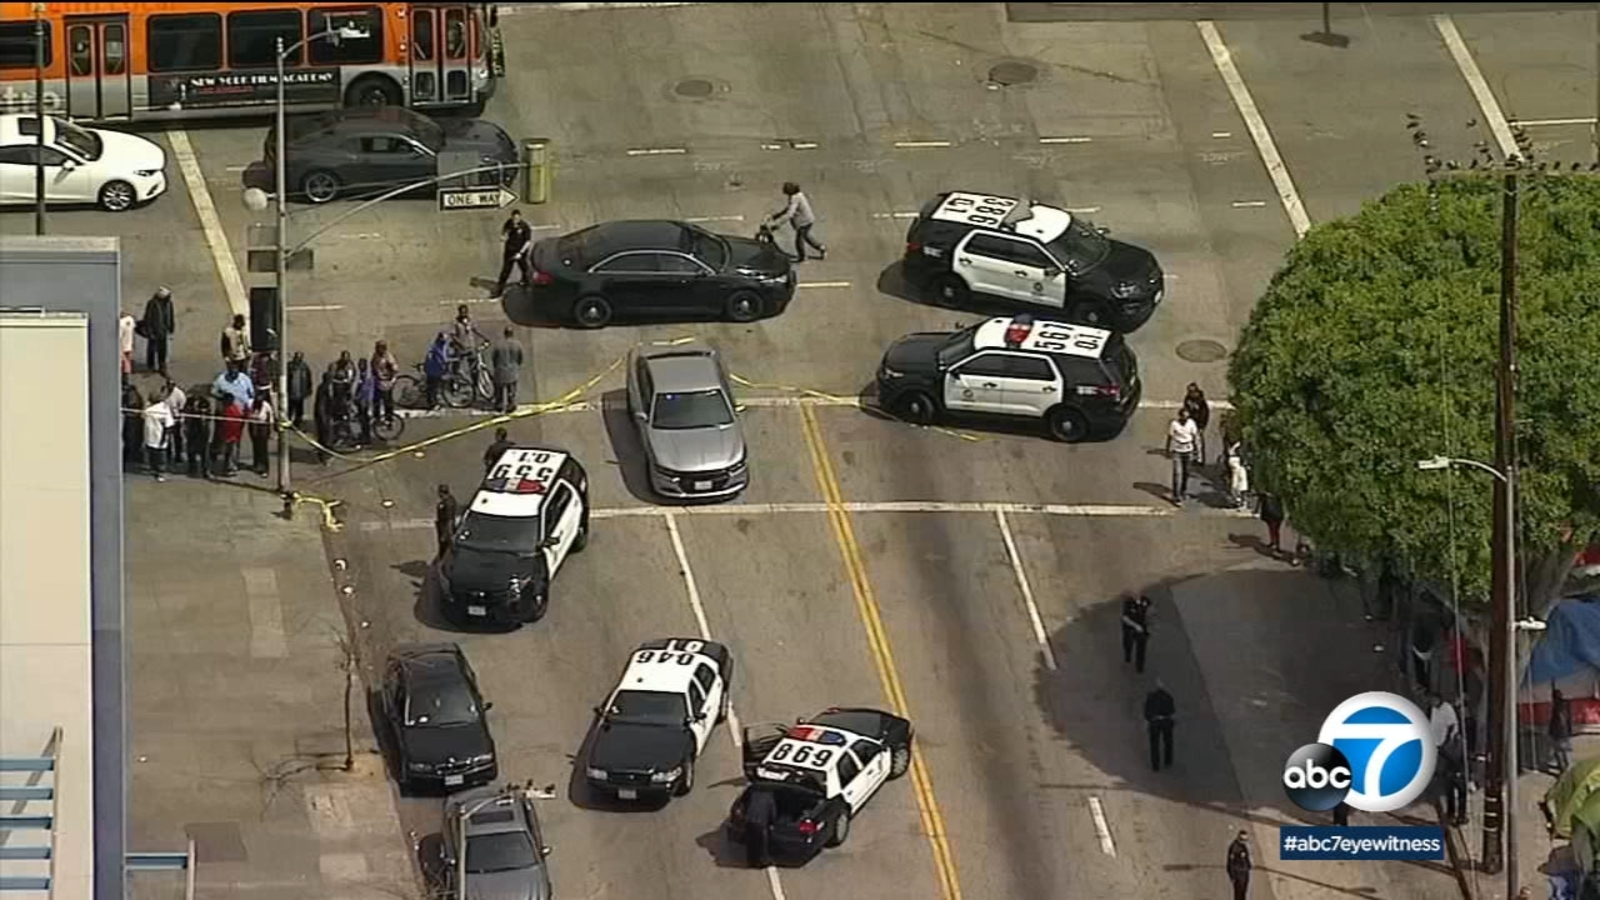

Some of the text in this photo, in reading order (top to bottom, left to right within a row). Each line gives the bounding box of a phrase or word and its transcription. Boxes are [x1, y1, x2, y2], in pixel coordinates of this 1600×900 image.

[190, 72, 333, 86] NEW YORK FILM ACADEMY
[447, 192, 501, 206] ONE WAY
[771, 742, 834, 768] 869
